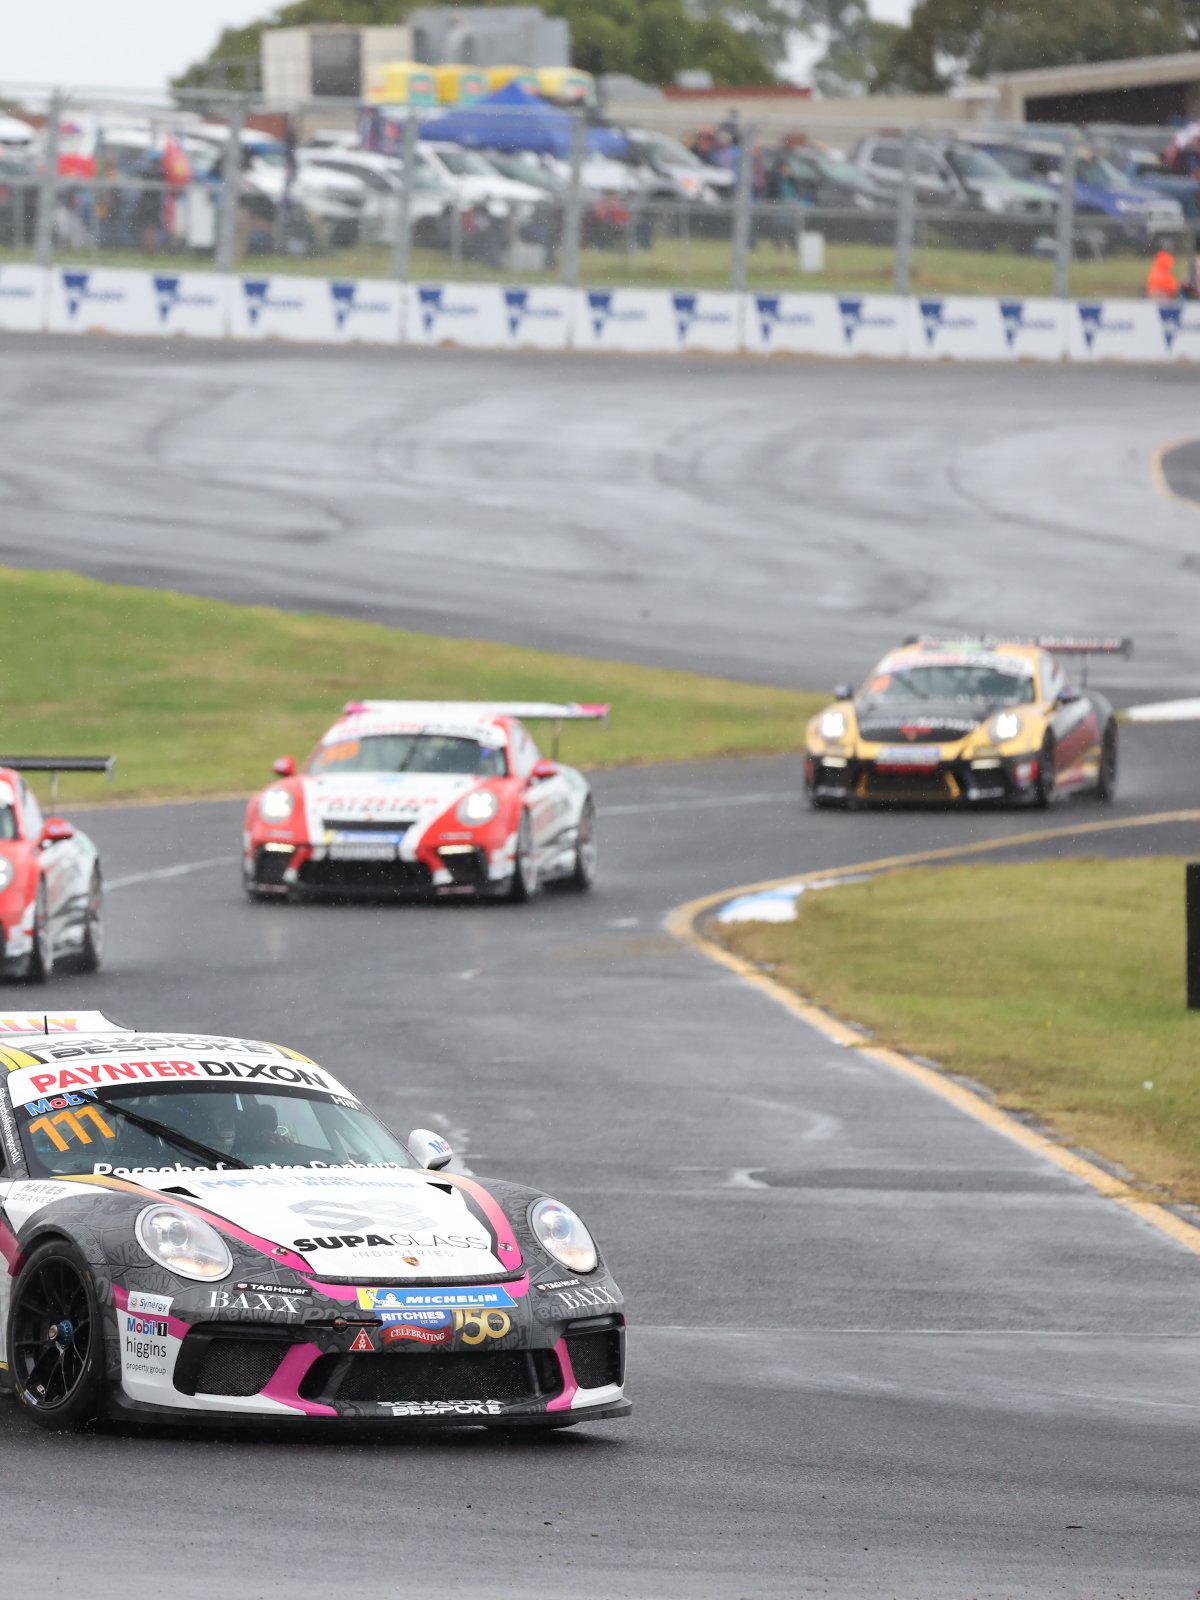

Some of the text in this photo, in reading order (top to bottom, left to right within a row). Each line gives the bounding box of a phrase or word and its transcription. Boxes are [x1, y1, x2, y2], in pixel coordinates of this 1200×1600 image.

[50, 1042, 273, 1059] BESPOKE
[29, 1060, 330, 1093] PAYNTER DIXON
[330, 1095, 360, 1111] Hill
[28, 1105, 116, 1152] 111
[20, 1182, 67, 1196] HAYES
[200, 1178, 288, 1189] MFW
[12, 1193, 54, 1204] CRANES
[351, 1249, 454, 1260] INDUSTRIES
[139, 1298, 168, 1313] Synergy
[205, 1290, 302, 1314] BAXX
[405, 1294, 498, 1304] MICHELIN
[556, 1286, 619, 1310] BAXX
[381, 1310, 446, 1322] RITCHIES
[127, 1317, 156, 1336] Mobil
[452, 1308, 511, 1345] 150
[390, 1329, 446, 1343] CELEBRATING
[126, 1335, 167, 1359] higgins
[126, 1362, 167, 1376] property group
[392, 1405, 503, 1417] BESPOKE
